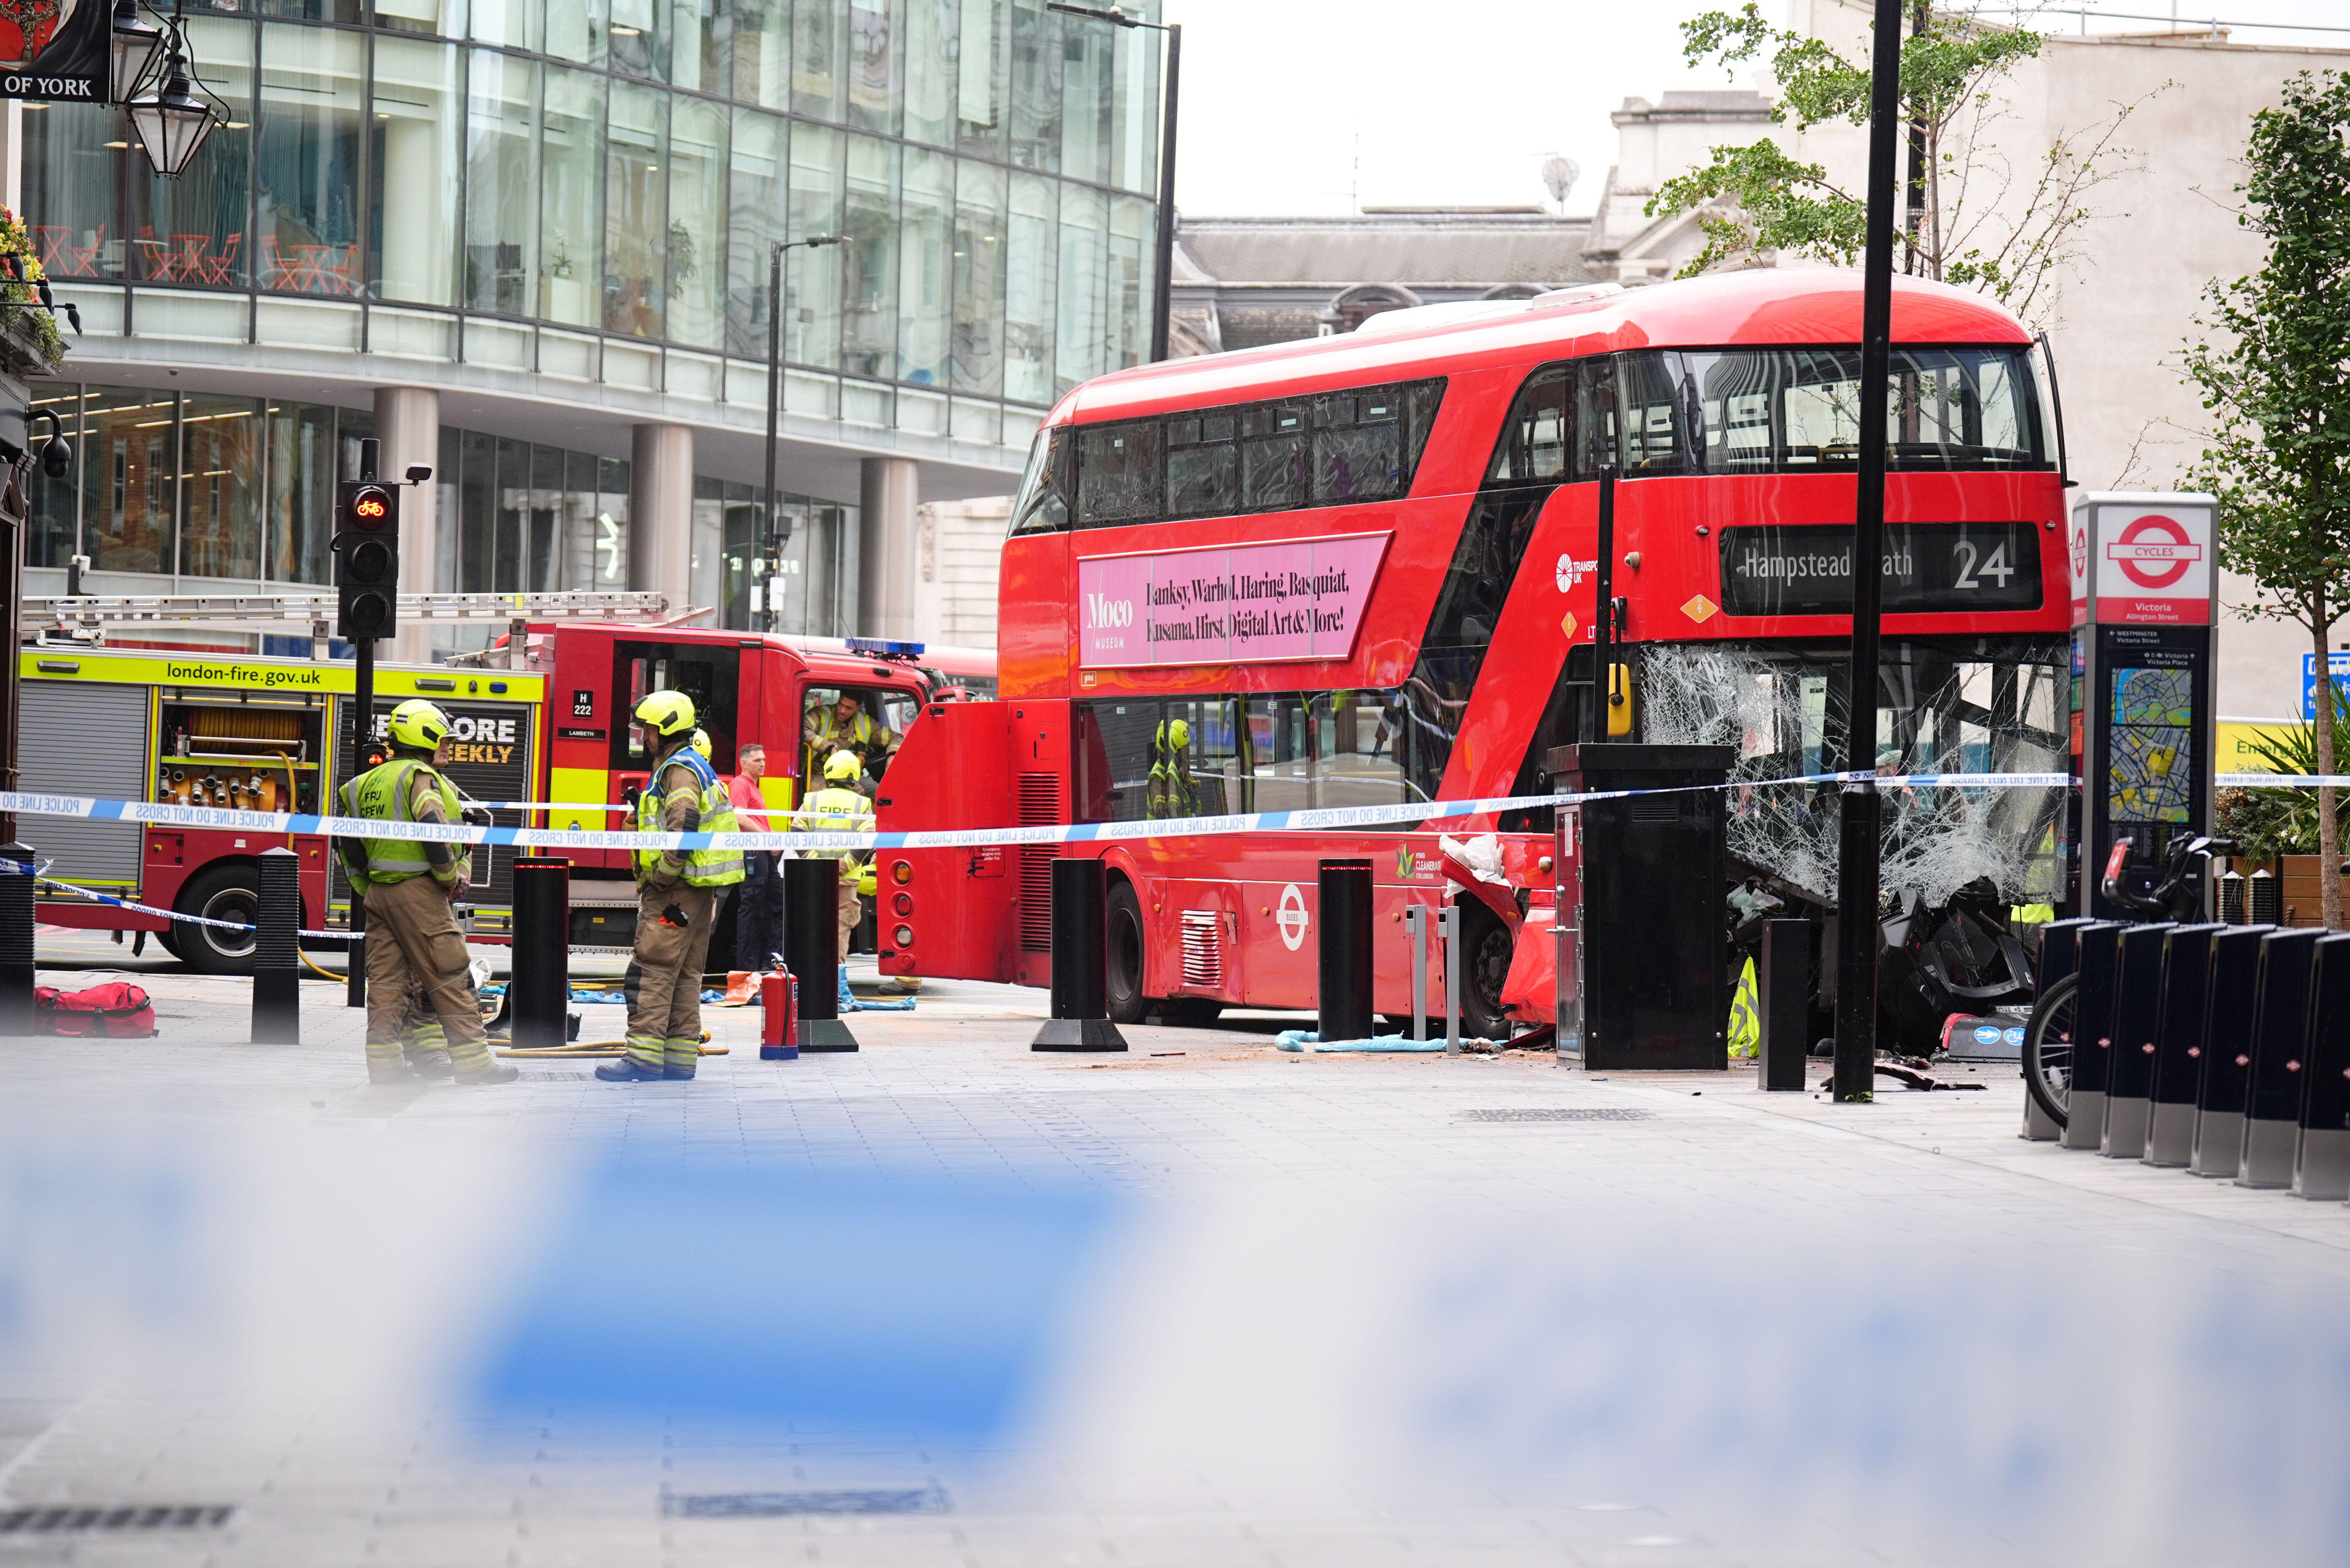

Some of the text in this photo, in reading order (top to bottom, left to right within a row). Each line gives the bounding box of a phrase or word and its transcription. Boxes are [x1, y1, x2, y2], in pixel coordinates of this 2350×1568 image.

[5, 76, 92, 96] OF YORK
[2135, 548, 2173, 556] CYCLES
[1745, 545, 1912, 586] Hampstead ath
[1954, 541, 2013, 588] 24
[1574, 572, 1582, 583] UK
[1146, 566, 1349, 610] Banksy, Warhol, Haring, Basquiat,
[1087, 593, 1132, 628] Moco
[2136, 603, 2171, 611] Victoria
[1146, 605, 1344, 643] Kusama, Hirst, Digital Art & More!
[1095, 636, 1124, 649] MUSEUM
[167, 663, 320, 686] london-fire.gov.uk
[580, 694, 586, 703] H
[575, 705, 591, 715] 222
[453, 718, 515, 742] ORE
[448, 744, 514, 763] EKLY
[2237, 741, 2299, 758] Emerge
